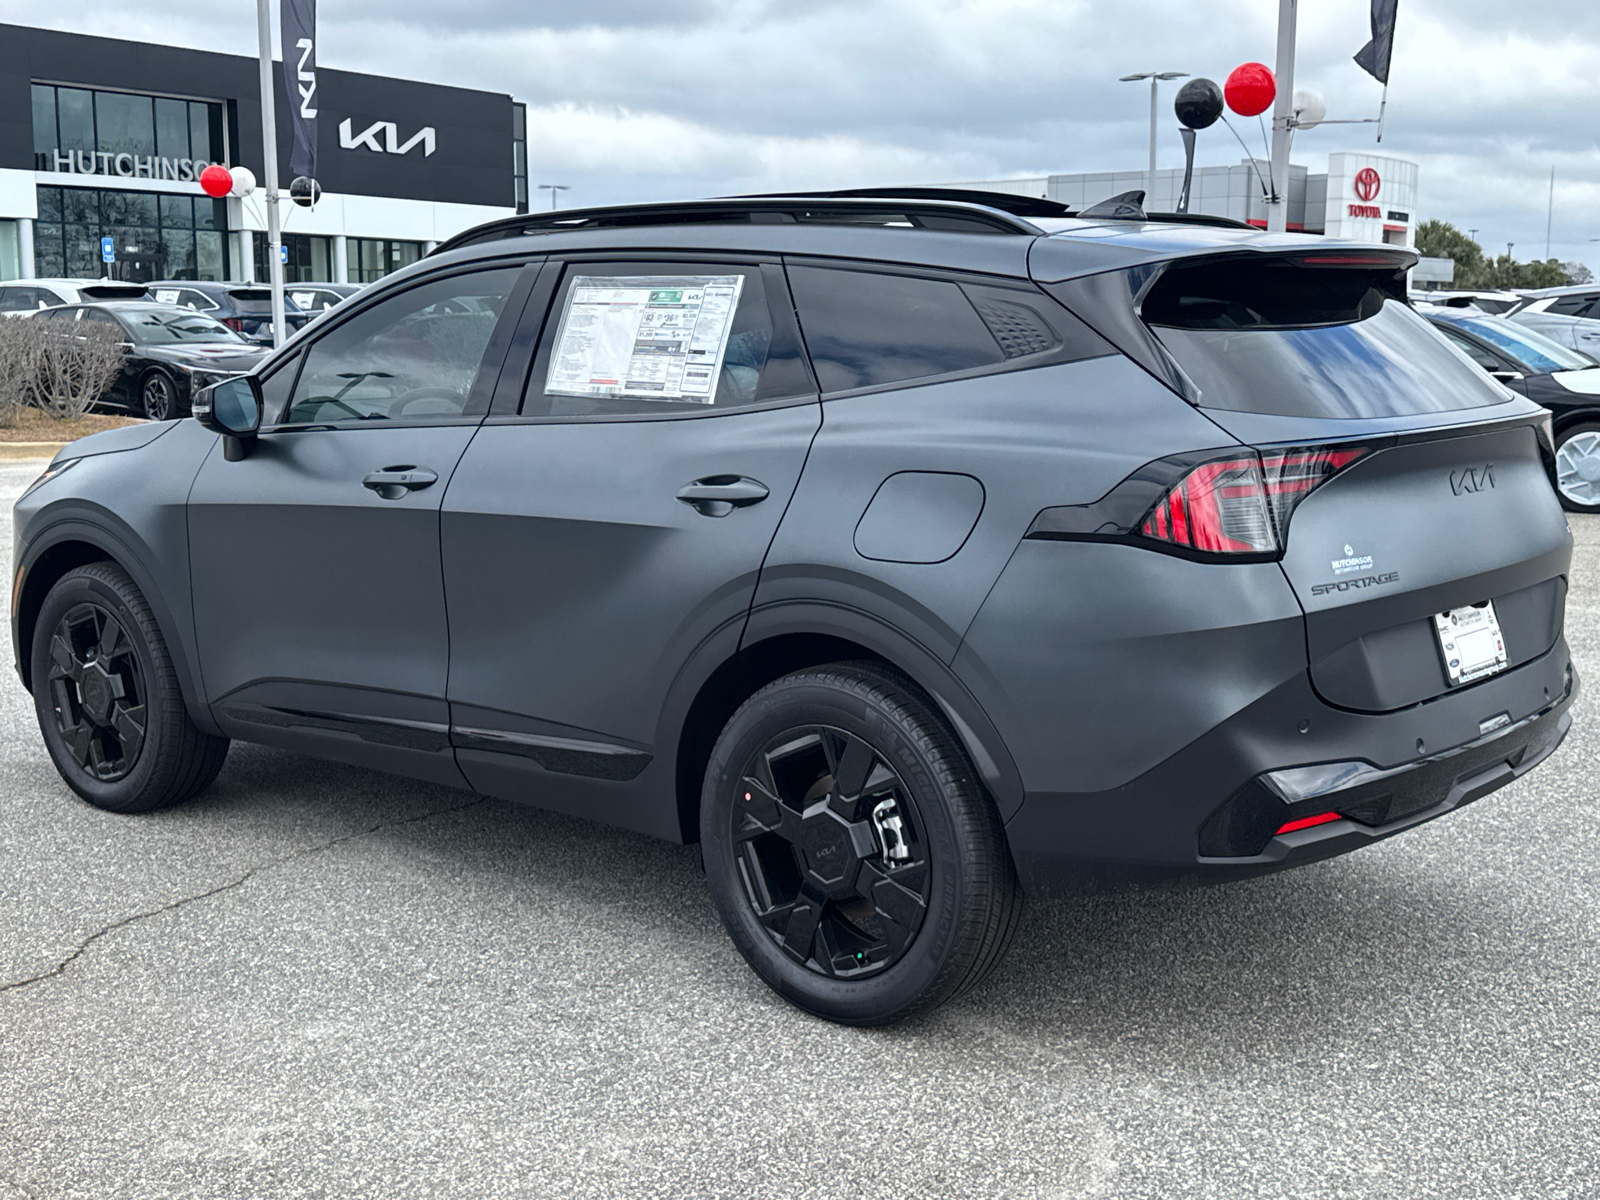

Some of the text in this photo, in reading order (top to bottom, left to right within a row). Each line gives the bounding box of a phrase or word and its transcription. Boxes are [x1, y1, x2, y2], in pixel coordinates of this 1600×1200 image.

[339, 117, 436, 157] KIA
[1348, 204, 1382, 219] TOYOTA
[1449, 463, 1496, 496] KIA
[1331, 555, 1374, 570] HUTCHINSON
[1311, 571, 1400, 596] SPORTAGE
[816, 845, 836, 858] KIA
